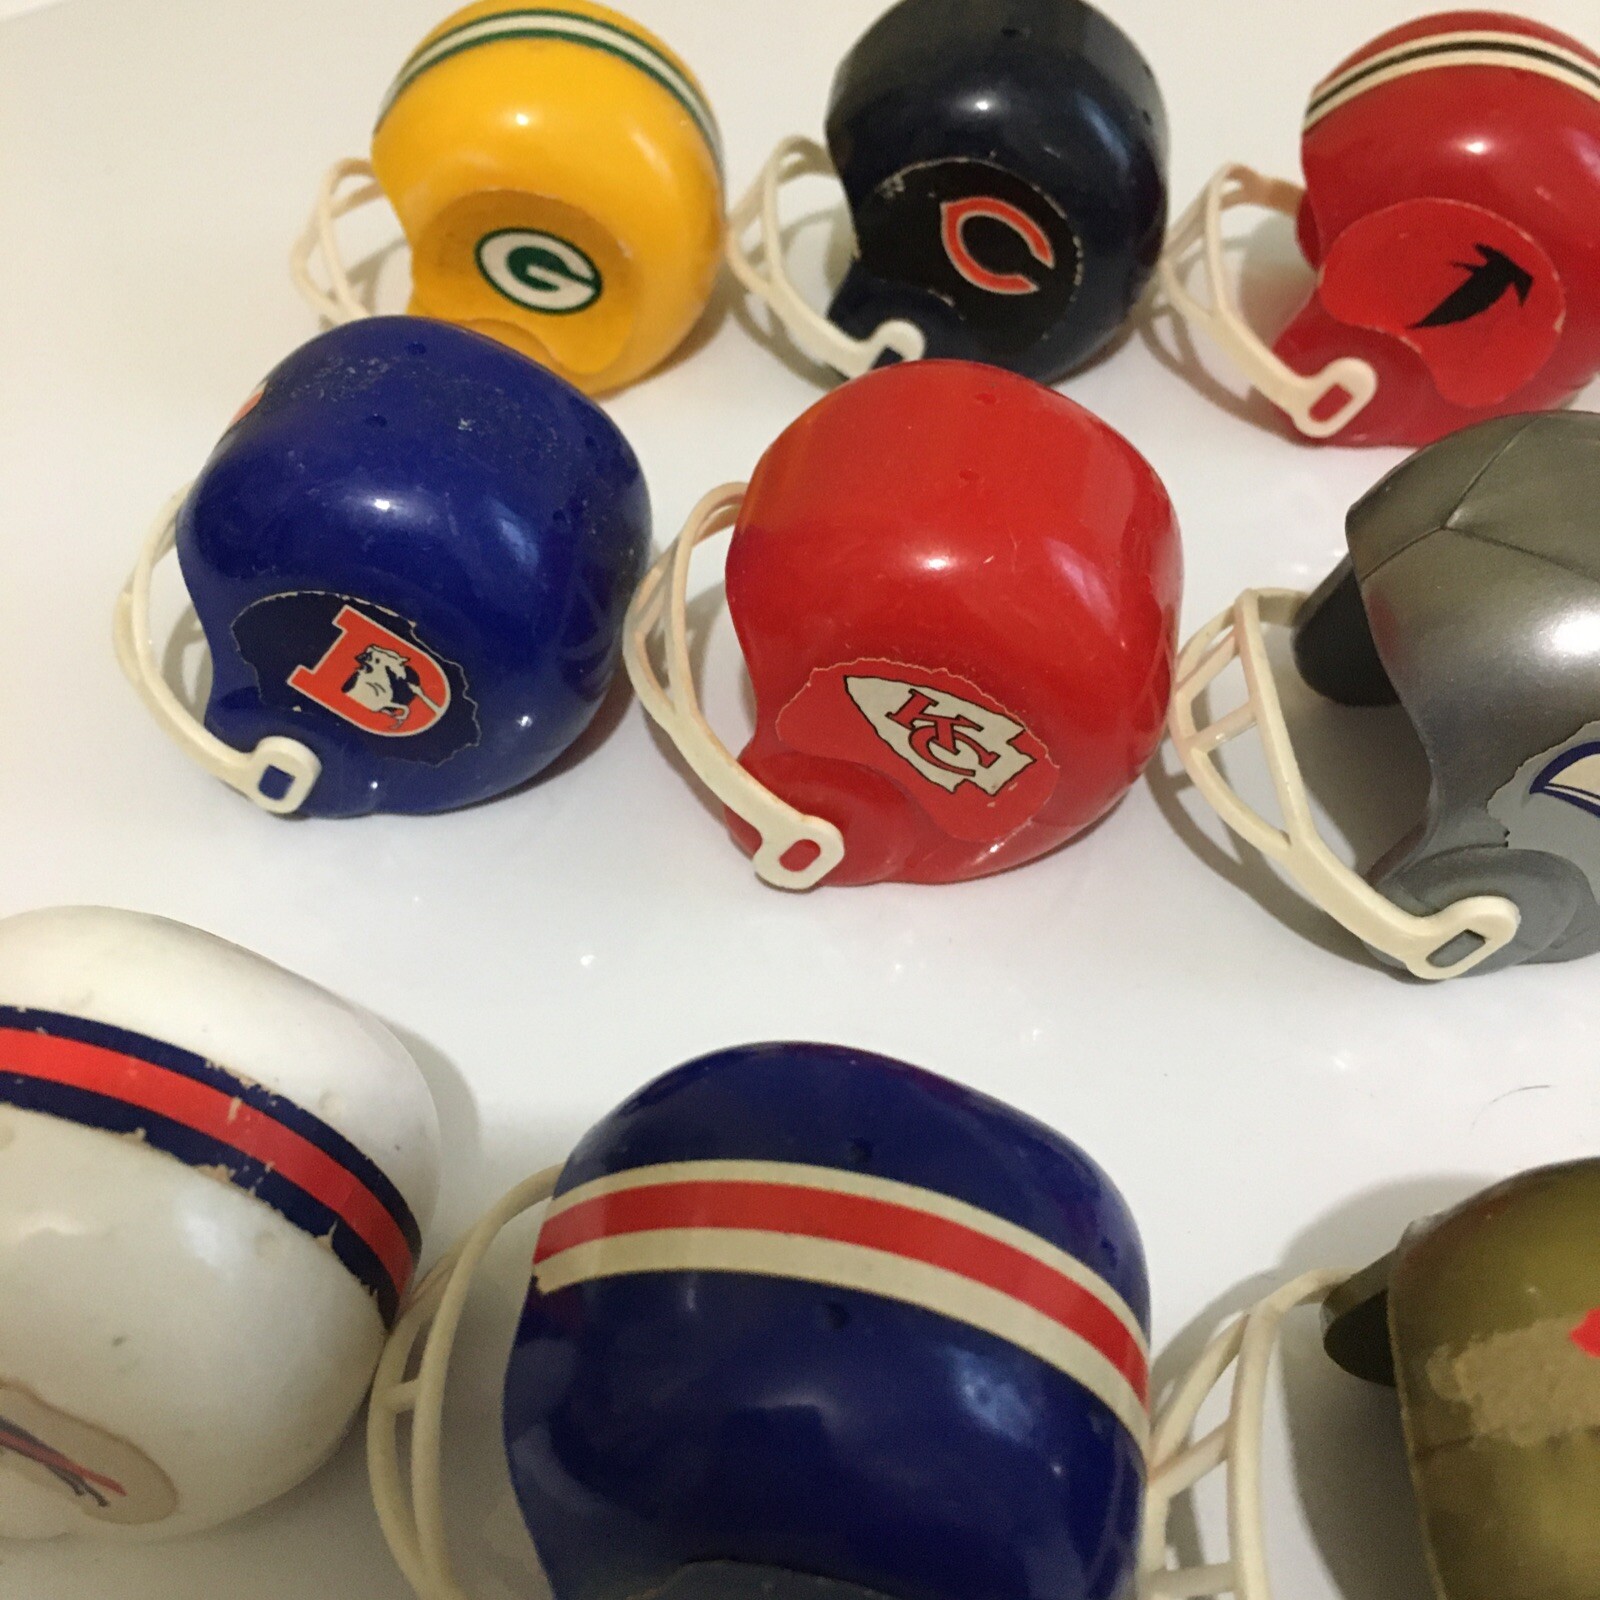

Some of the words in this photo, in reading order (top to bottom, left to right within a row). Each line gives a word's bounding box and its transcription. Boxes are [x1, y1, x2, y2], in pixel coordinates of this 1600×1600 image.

[476, 229, 602, 315] G
[940, 196, 1055, 295] C
[287, 604, 451, 737] D
[885, 688, 1001, 777] KC
